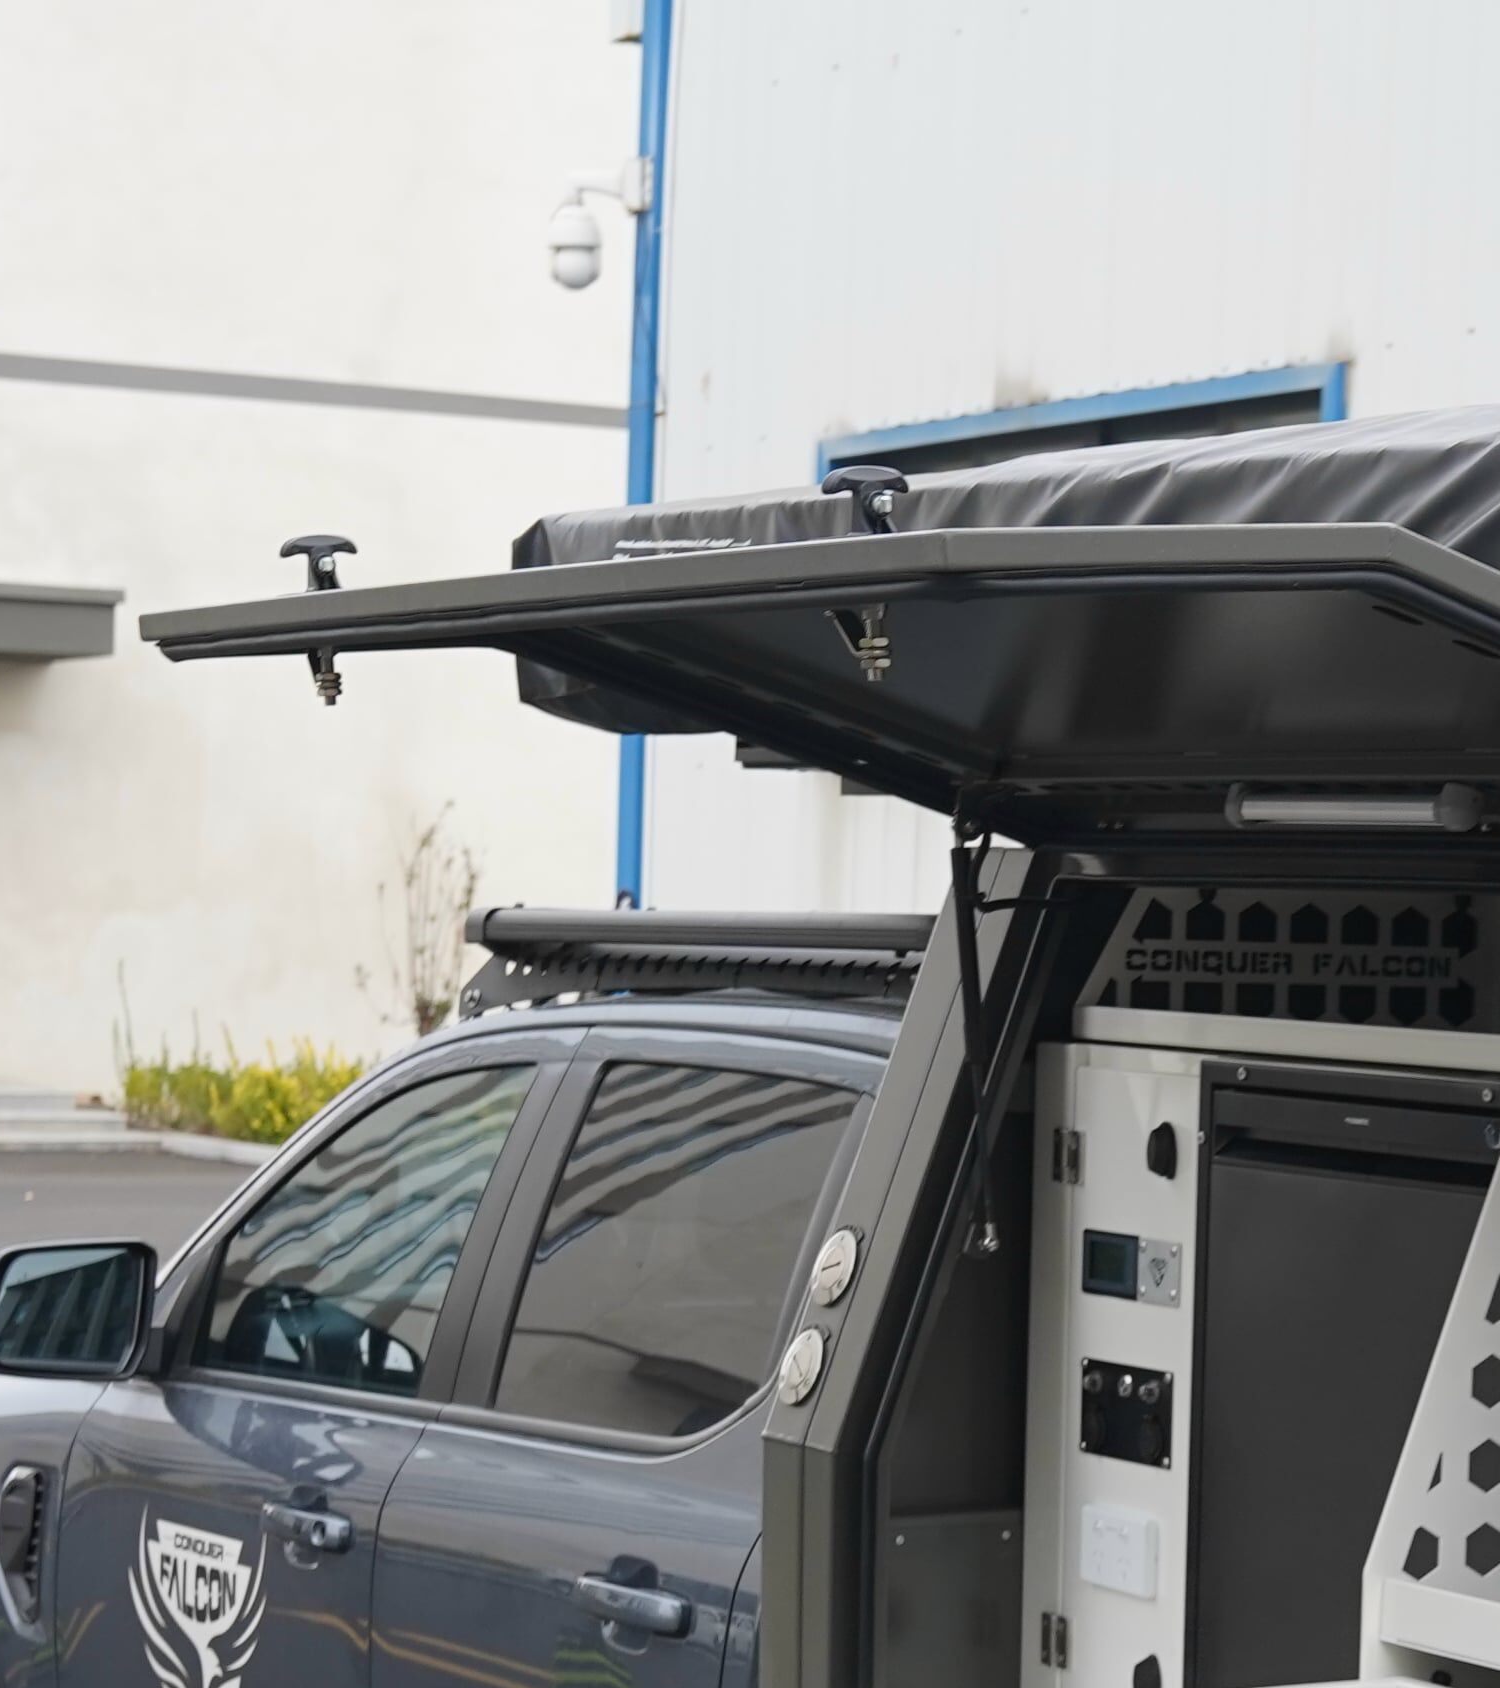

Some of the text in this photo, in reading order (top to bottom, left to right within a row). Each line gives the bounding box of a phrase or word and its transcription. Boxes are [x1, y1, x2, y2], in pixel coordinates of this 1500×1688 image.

[1126, 949, 1451, 978] CONQUER FALCON
[174, 1533, 224, 1561] CONQUER
[160, 1552, 237, 1623] FALCON
